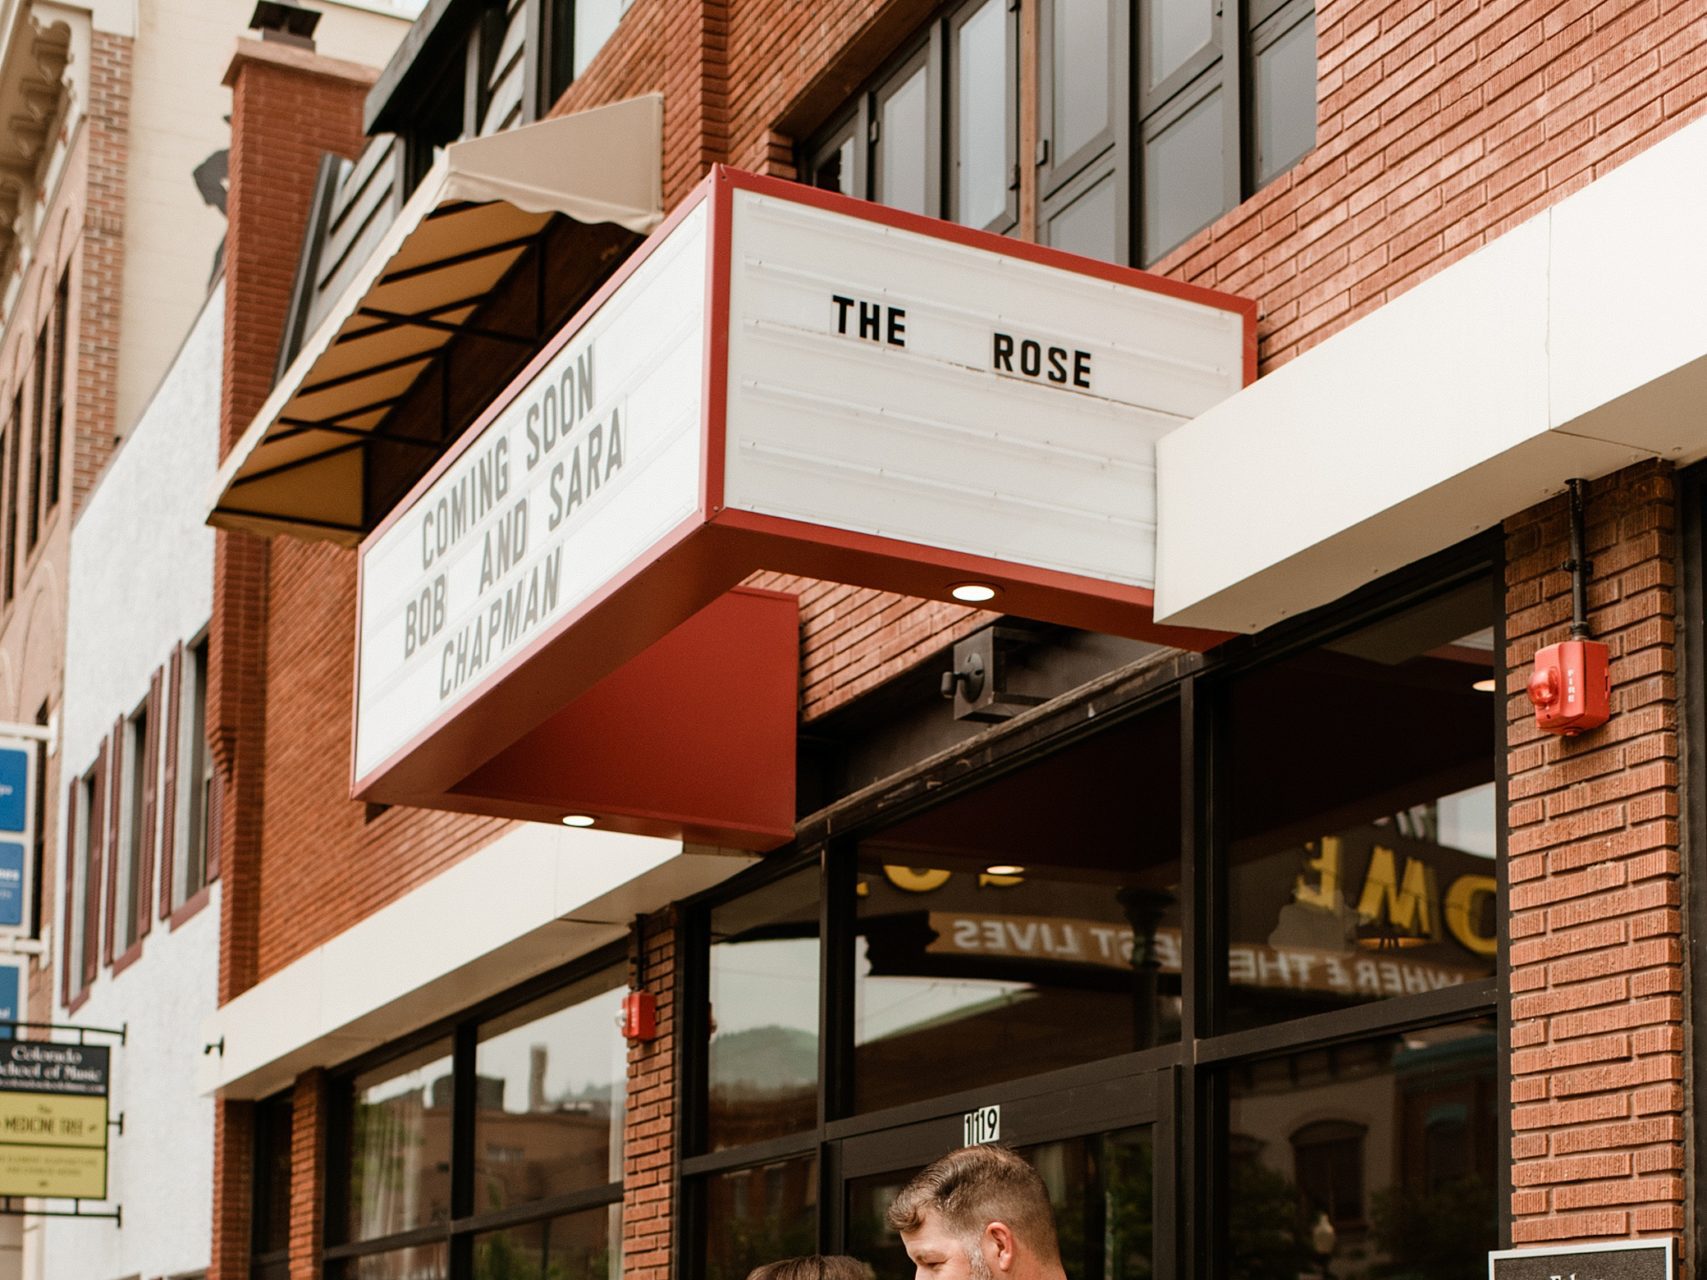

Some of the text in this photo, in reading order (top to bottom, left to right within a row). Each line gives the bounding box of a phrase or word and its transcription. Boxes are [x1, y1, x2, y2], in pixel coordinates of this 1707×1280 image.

[832, 294, 1092, 388] THE ROSE
[422, 343, 595, 570] COMING SOON
[404, 407, 624, 660] BOB AND SARA
[439, 544, 564, 701] CHAPMAN
[1567, 669, 1576, 703] FIRE
[0, 1061, 40, 1078] chool
[43, 1064, 61, 1079] of
